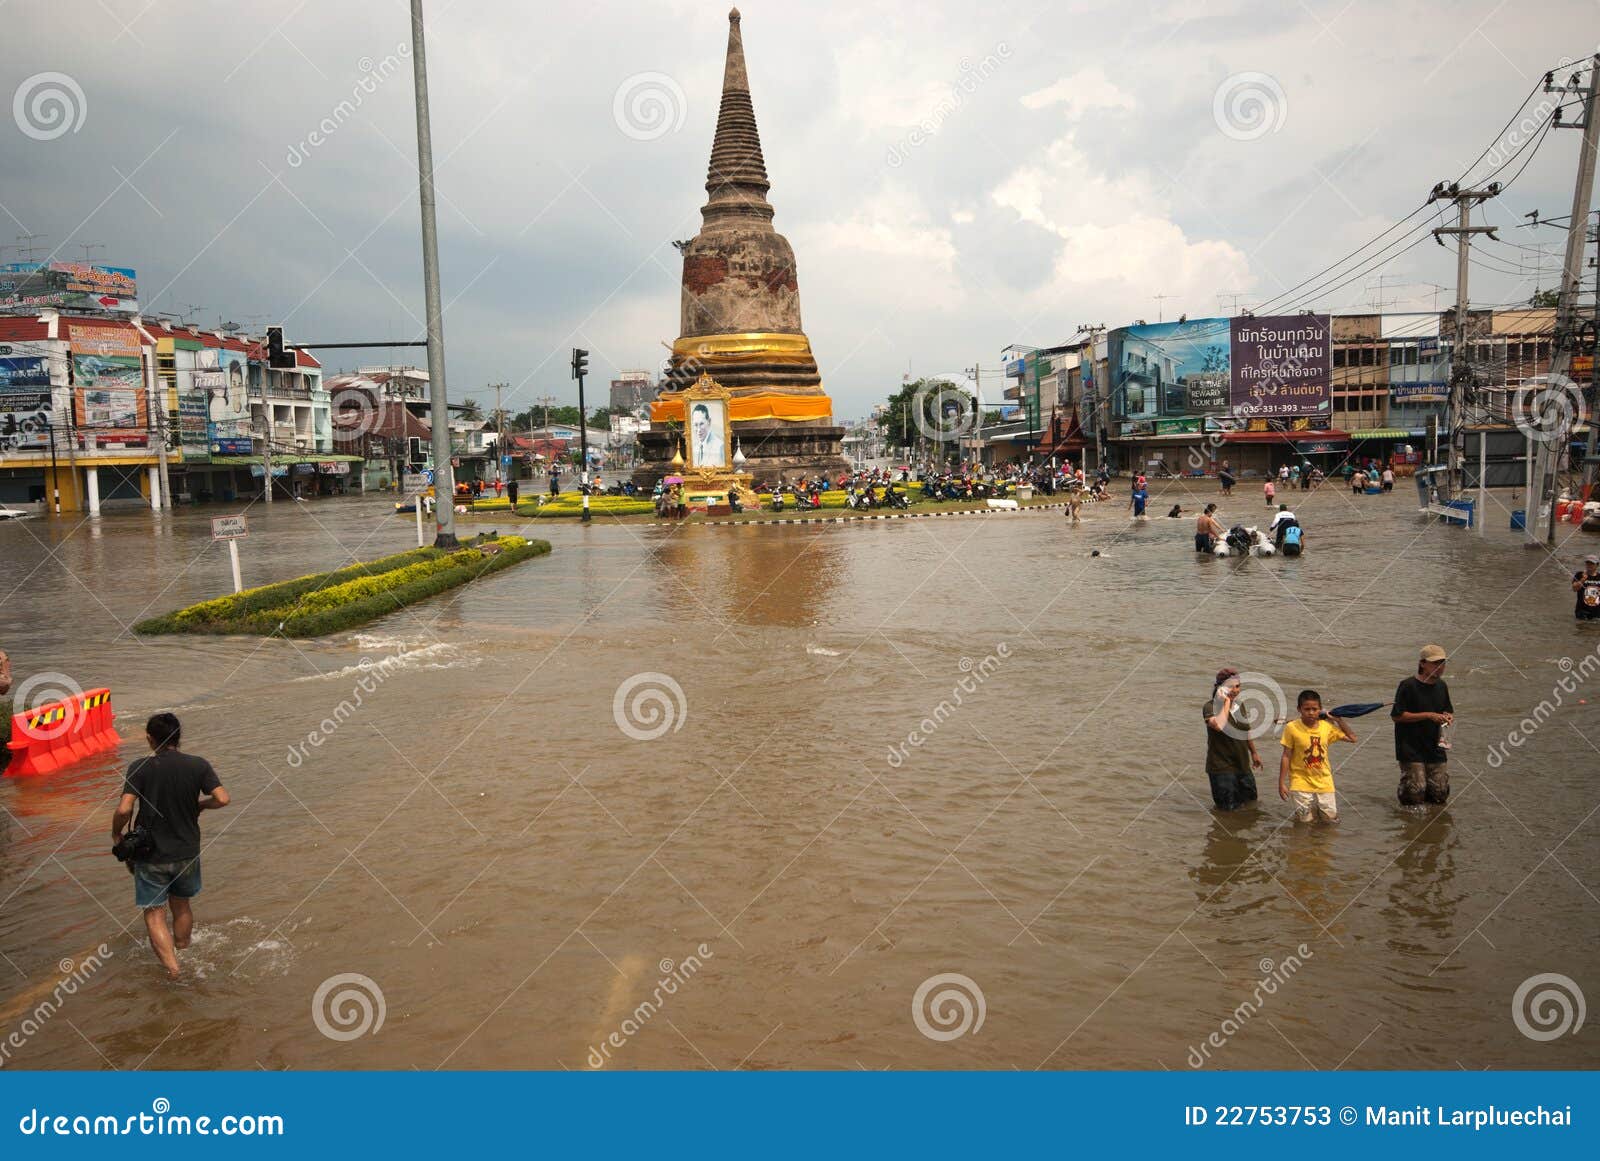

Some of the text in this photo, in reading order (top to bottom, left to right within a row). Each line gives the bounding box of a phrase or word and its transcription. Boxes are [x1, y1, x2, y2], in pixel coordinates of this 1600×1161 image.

[1238, 326, 1323, 345] พักร้อนทุกวัน
[1243, 404, 1298, 414] 035-331-393
